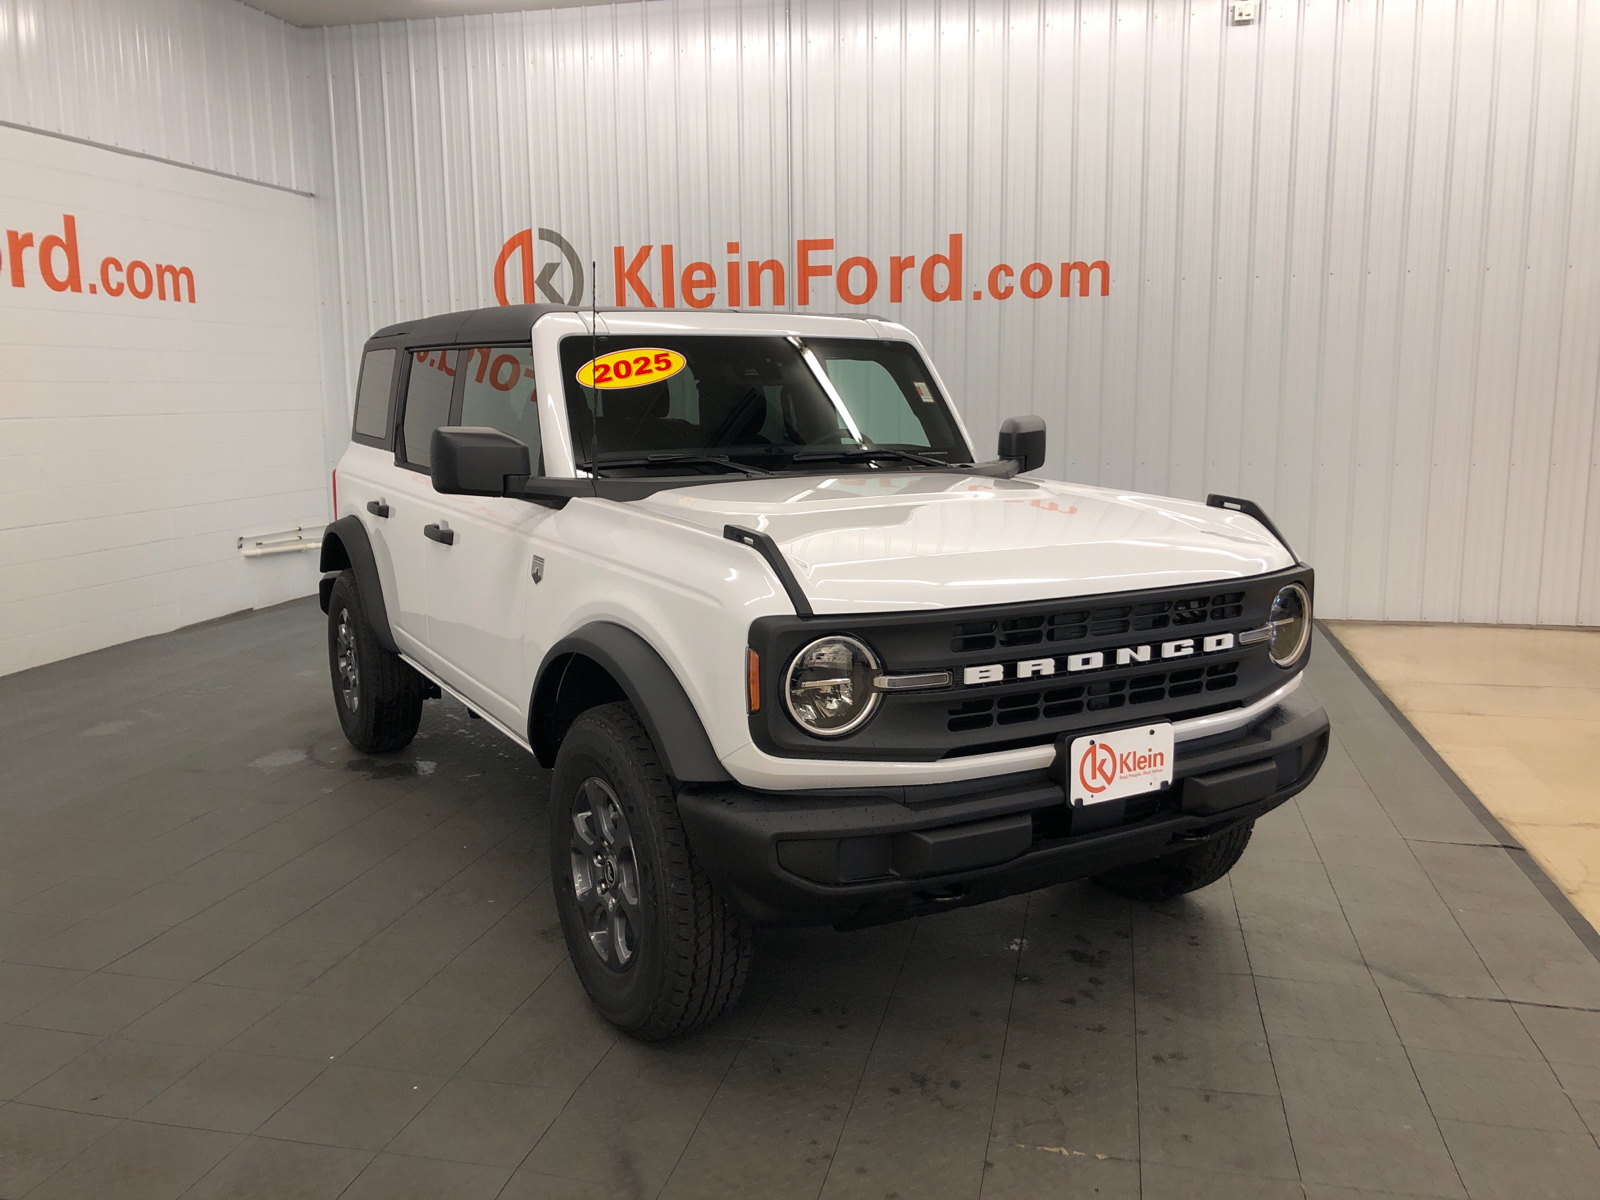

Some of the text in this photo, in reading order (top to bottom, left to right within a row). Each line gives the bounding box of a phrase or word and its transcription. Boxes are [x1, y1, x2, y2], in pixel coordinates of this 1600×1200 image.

[0, 213, 196, 304] rd.com
[613, 233, 1110, 308] KleinFord.com
[592, 352, 673, 384] 2025
[963, 633, 1234, 685] BRONCO
[1119, 748, 1164, 774] Klein
